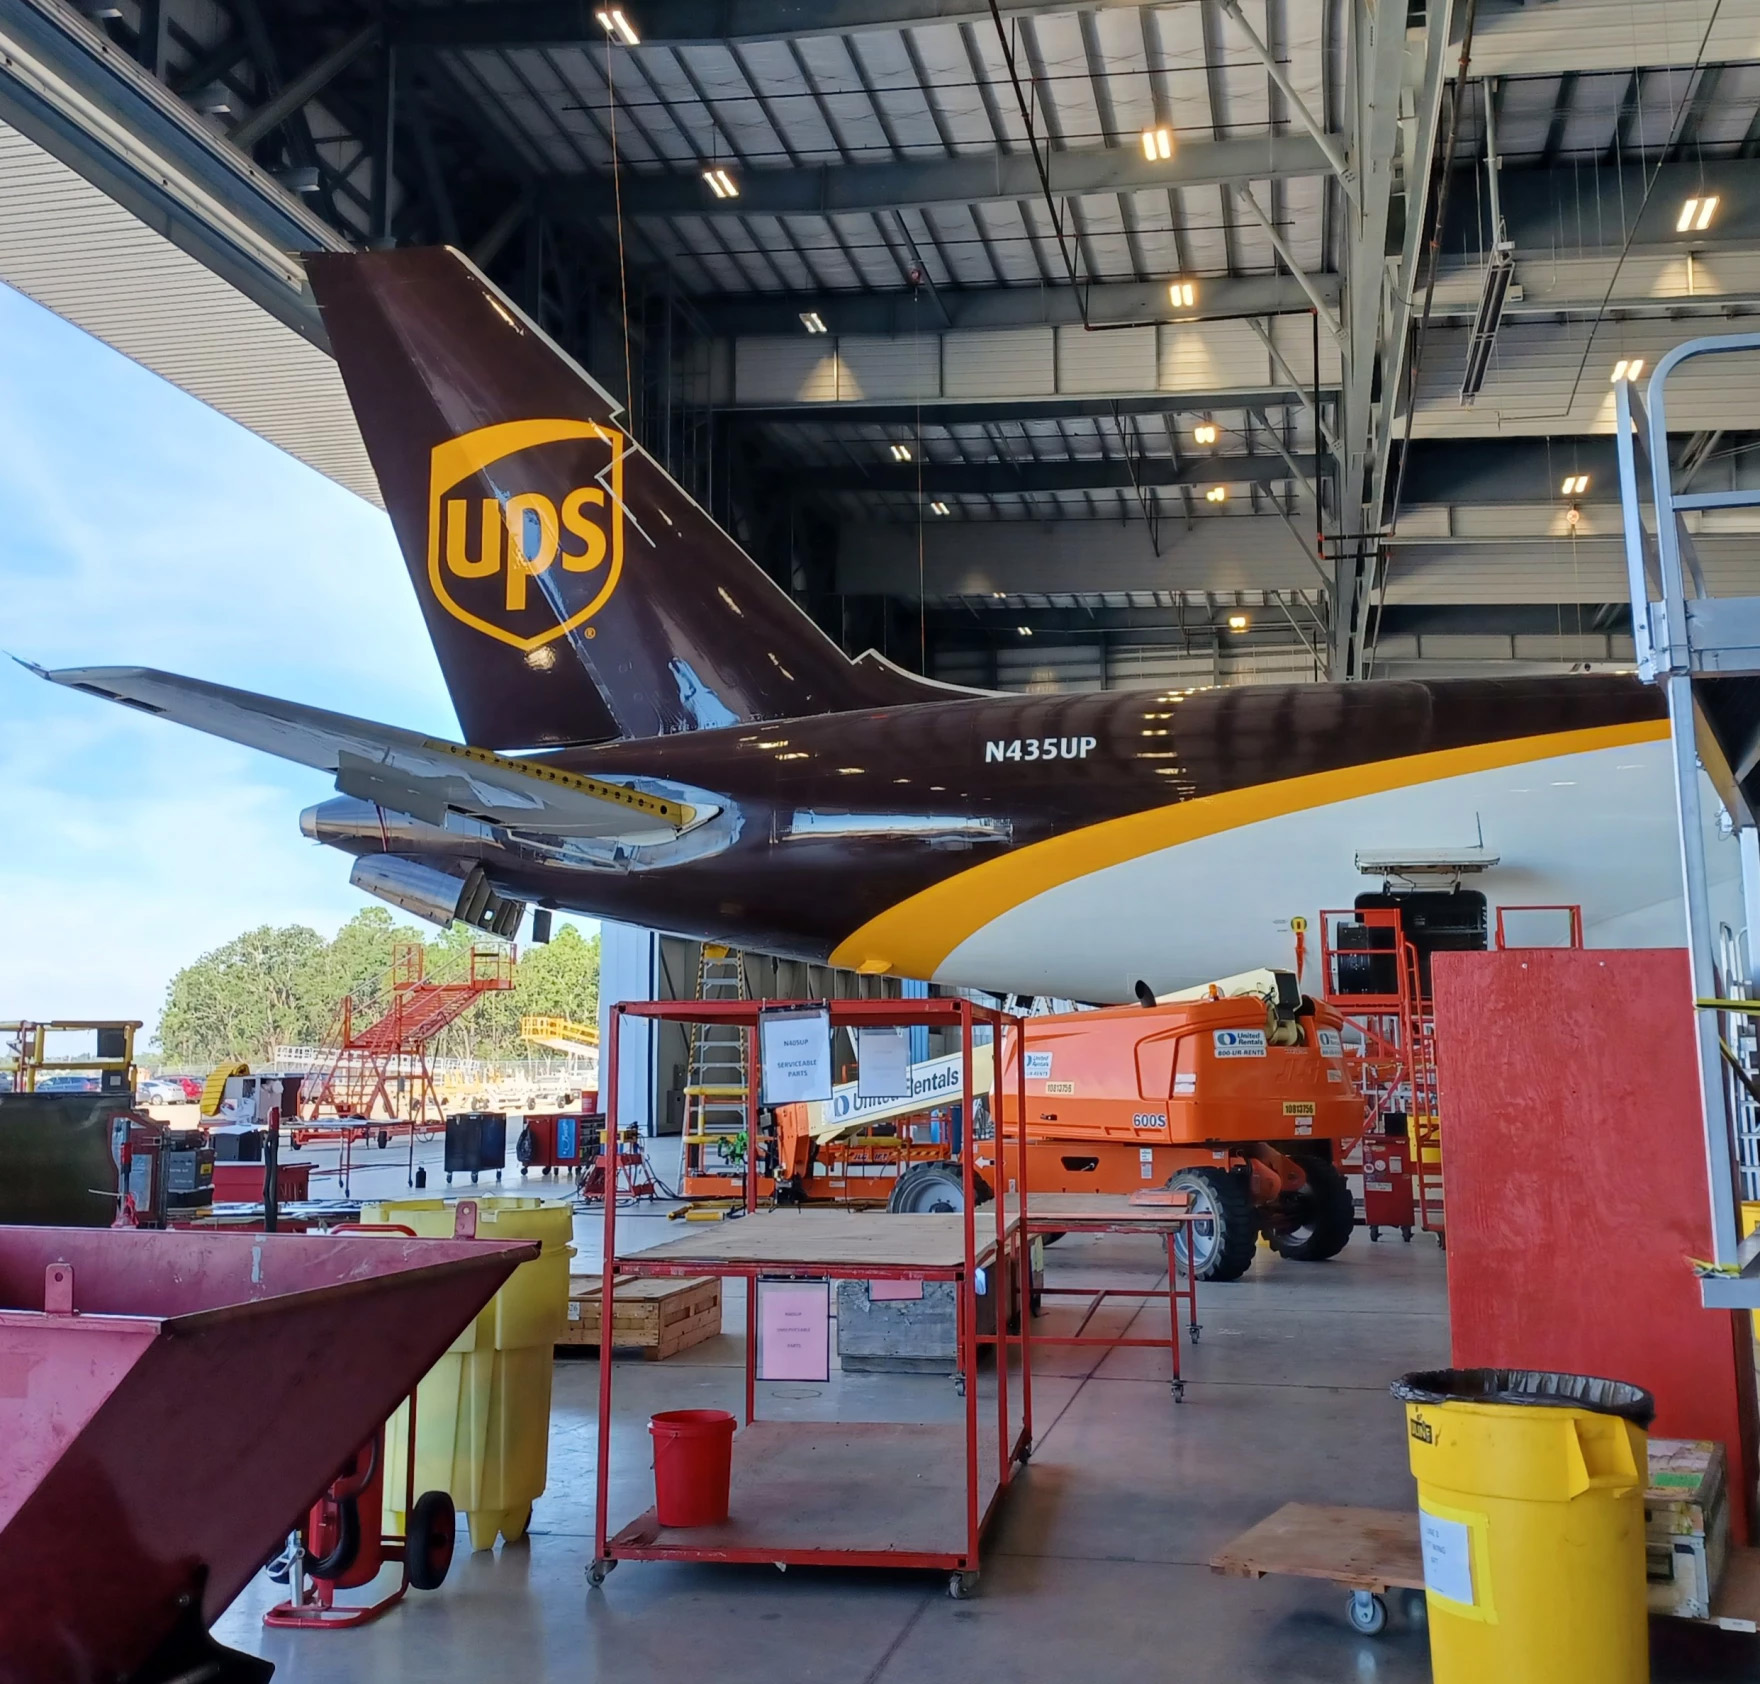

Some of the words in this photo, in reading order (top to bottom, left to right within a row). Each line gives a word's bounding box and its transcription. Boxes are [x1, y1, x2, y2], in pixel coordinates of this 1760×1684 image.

[446, 487, 606, 611] ups
[985, 736, 1097, 763] N435UP
[777, 1059, 817, 1069] SERVICEABLE
[787, 1070, 808, 1078] PARTS
[1285, 1104, 1314, 1114] 10813756
[1133, 1113, 1167, 1128] 600S
